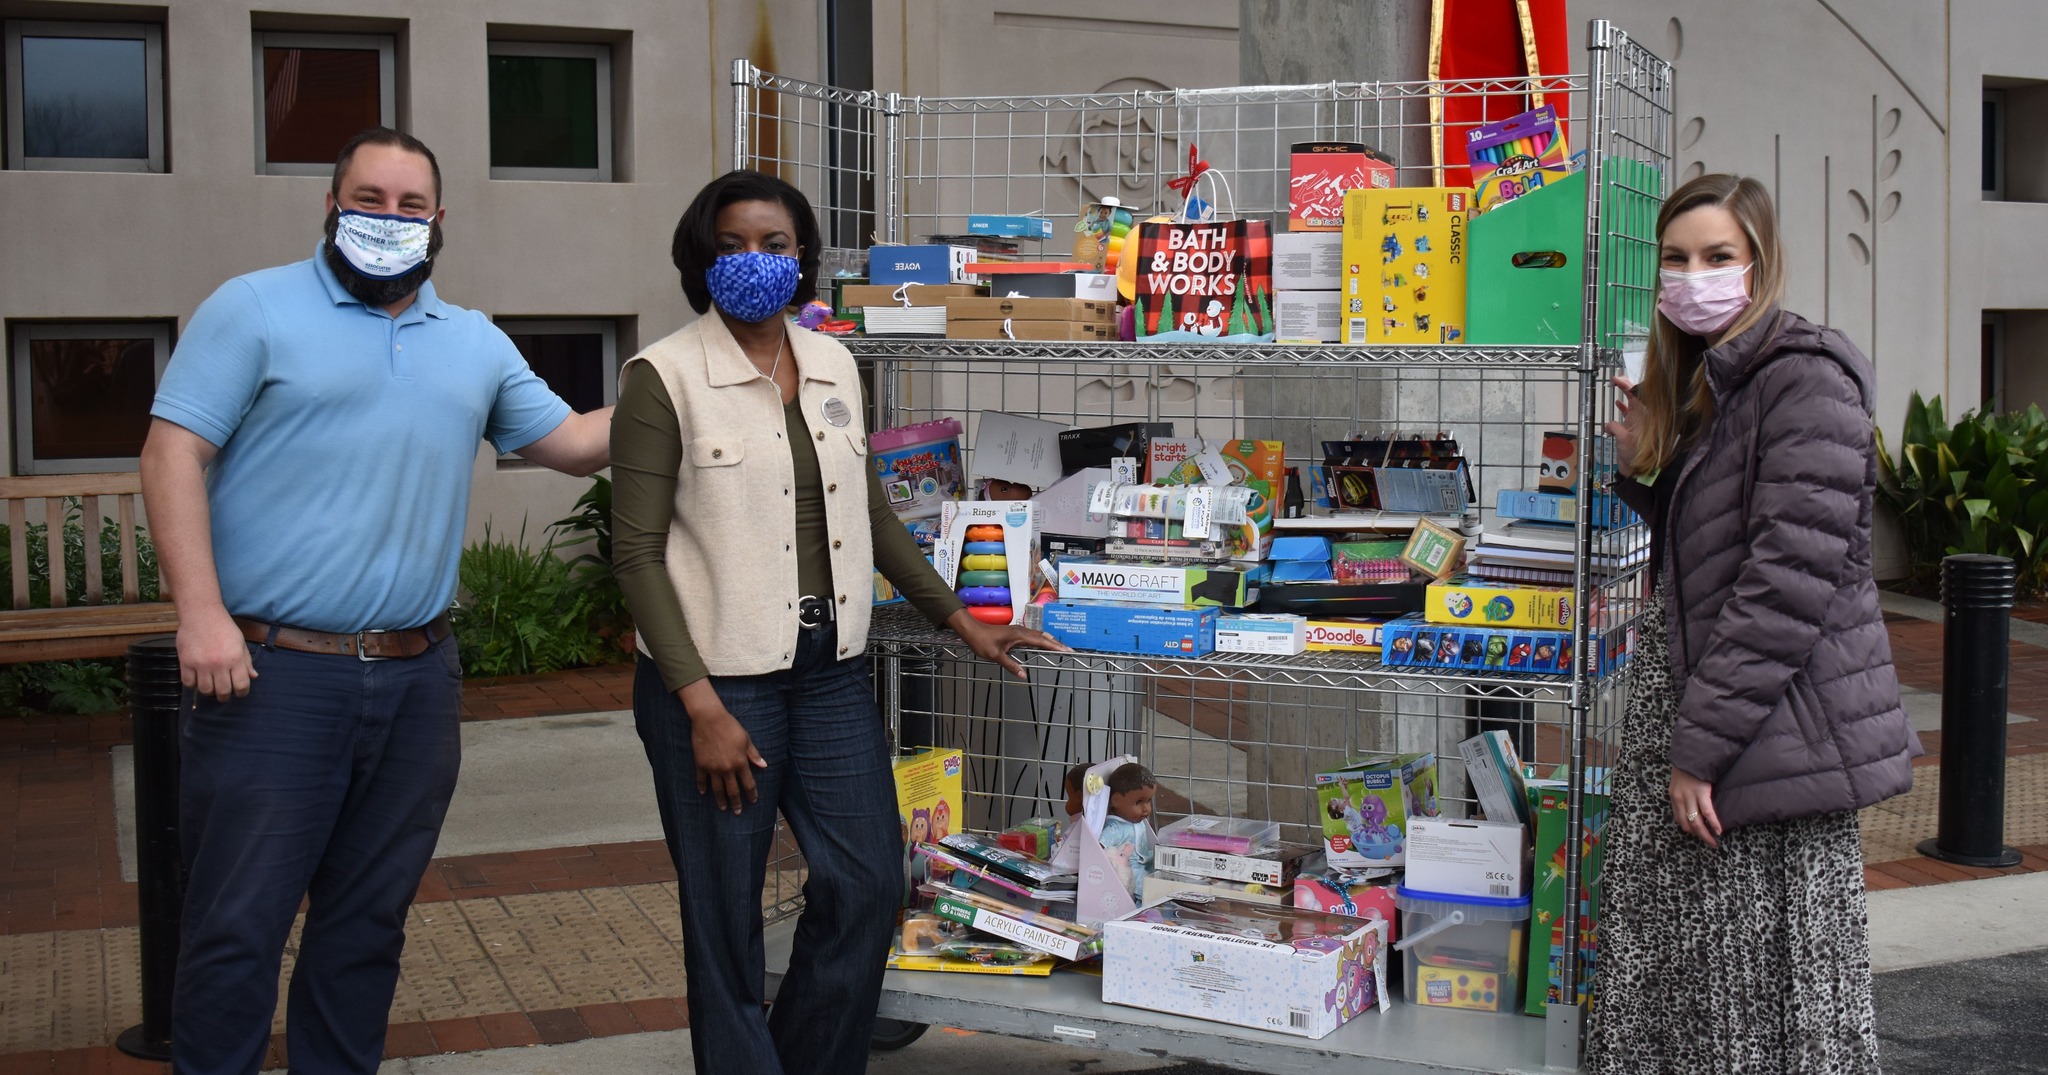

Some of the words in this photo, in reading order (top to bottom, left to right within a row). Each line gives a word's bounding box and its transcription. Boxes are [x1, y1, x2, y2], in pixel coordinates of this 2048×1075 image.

[1470, 130, 1482, 142] 10
[1499, 171, 1544, 199] Bold
[348, 227, 386, 245] TOGETHER
[1168, 228, 1227, 250] BATH
[895, 262, 921, 270] VOYEE
[1150, 251, 1170, 272] &
[1172, 250, 1236, 273] BODY
[1147, 273, 1236, 296] WORKS
[1060, 433, 1080, 441] TRAXX
[1154, 443, 1186, 454] bright
[1154, 453, 1186, 462] starts
[908, 460, 940, 475] blocks
[972, 508, 996, 517] Rings
[1081, 572, 1125, 587] MAVO
[1128, 574, 1179, 589] CRAFT
[1314, 627, 1366, 645] Doodle
[1164, 640, 1178, 648] CITY
[951, 906, 972, 915] NORBERG
[954, 910, 970, 920] LINDEN
[984, 915, 1024, 936] ACRYLIC
[1024, 925, 1051, 944] PAINT
[1051, 937, 1068, 950] SET
[1181, 930, 1215, 939] FRIENDS
[1217, 936, 1258, 946] COLLECTOR
